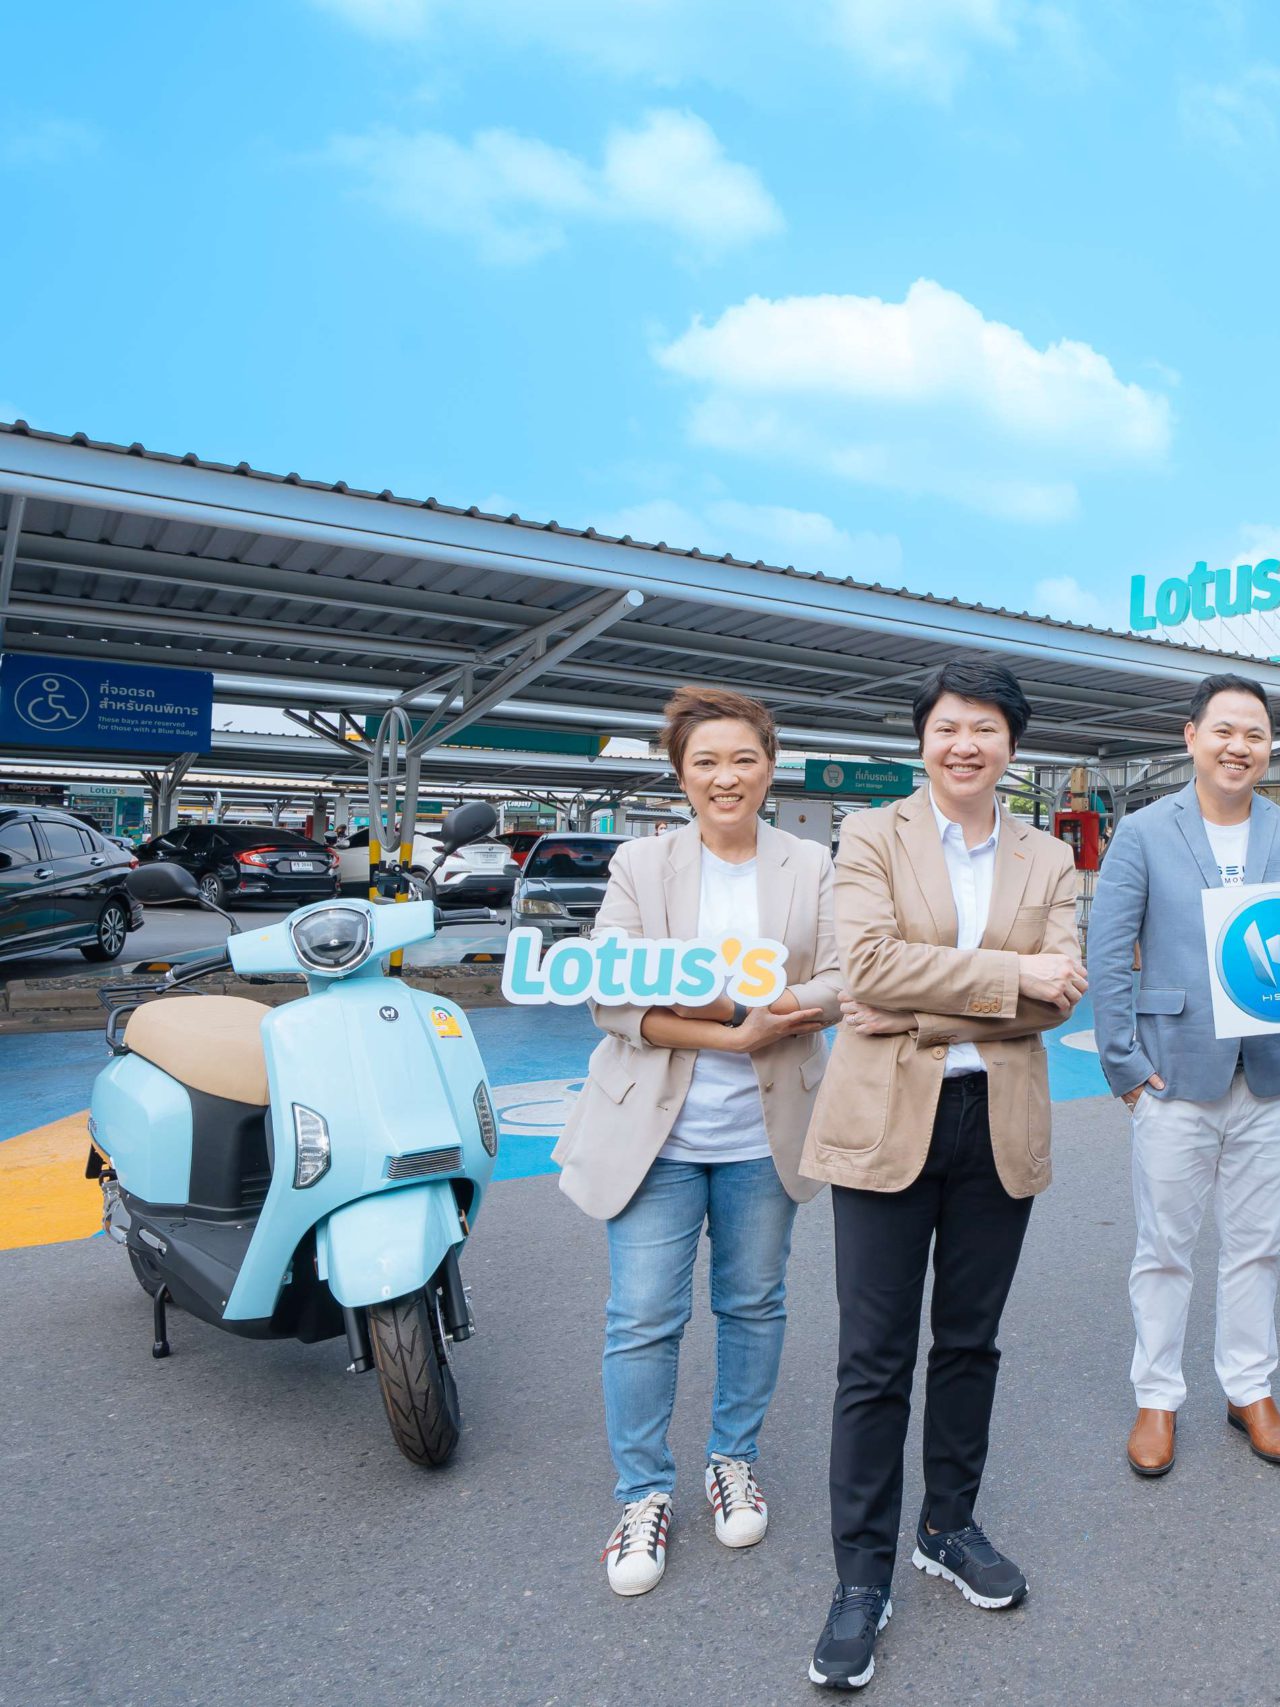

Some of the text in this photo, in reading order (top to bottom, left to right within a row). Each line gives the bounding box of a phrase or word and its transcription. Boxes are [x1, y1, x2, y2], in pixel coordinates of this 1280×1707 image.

[99, 680, 155, 698] ที่จอดรถ
[98, 697, 199, 716] สำหรับคนพิการ
[121, 717, 139, 726] bays
[154, 720, 185, 728] reserved
[110, 724, 132, 732] those
[158, 727, 175, 735] Blue
[175, 729, 198, 737] Badge
[855, 769, 899, 783] ที่เก็บรถเข็น
[90, 786, 125, 795] Lotus's
[511, 936, 778, 998] Lotus's
